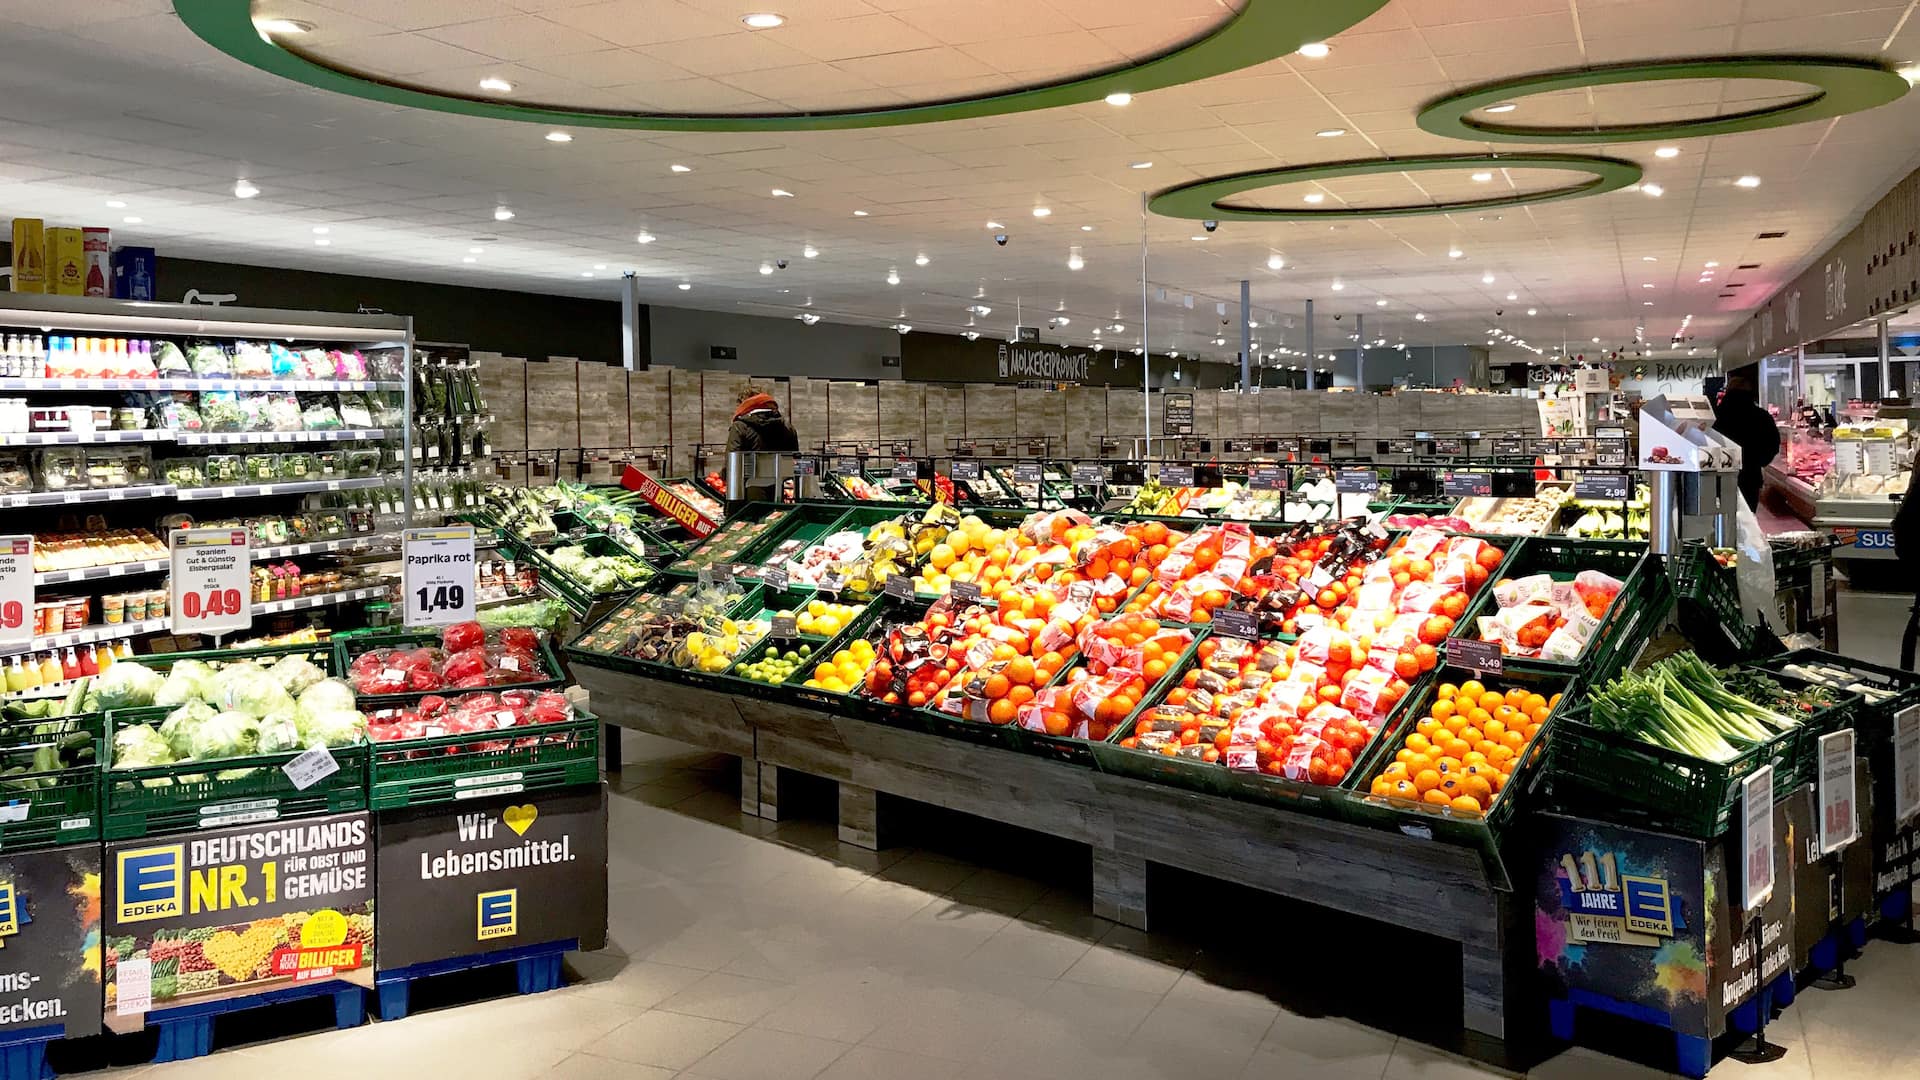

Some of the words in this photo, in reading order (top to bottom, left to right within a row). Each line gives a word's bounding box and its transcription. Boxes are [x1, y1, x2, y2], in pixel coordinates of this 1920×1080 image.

[1010, 348, 1089, 380] MOLKEREIPRODUKTE
[1604, 488, 1626, 498] 2,99
[655, 488, 700, 529] BILLIGER
[696, 520, 711, 535] AUF
[196, 548, 227, 556] Spanien
[208, 555, 236, 563] Günstig
[408, 553, 451, 566] Paprika
[453, 552, 471, 563] rot
[189, 563, 233, 572] Eisbergsalat
[183, 588, 242, 620] 0,49
[416, 585, 464, 614] 1,49
[1239, 625, 1257, 636] 2,99
[1479, 656, 1501, 668] 3,49
[457, 813, 498, 842] Wir
[190, 820, 366, 868] DEUTSCHLANDS
[284, 856, 307, 874] FÜR
[309, 853, 340, 870] OBST
[342, 849, 366, 866] UND
[420, 835, 576, 880] Lebensmittel.
[1560, 851, 1621, 893] 111
[284, 866, 367, 900] GEMÜSE
[1581, 892, 1618, 910] JAHRE
[123, 902, 177, 917] EDEKA
[1575, 916, 1591, 926] Wir
[1594, 919, 1619, 929] feiern
[1630, 919, 1669, 932] EDEKA
[481, 926, 513, 937] EDEKA
[1580, 927, 1595, 938] den
[1597, 929, 1620, 941] Preis!
[298, 949, 356, 969] BILLIGER
